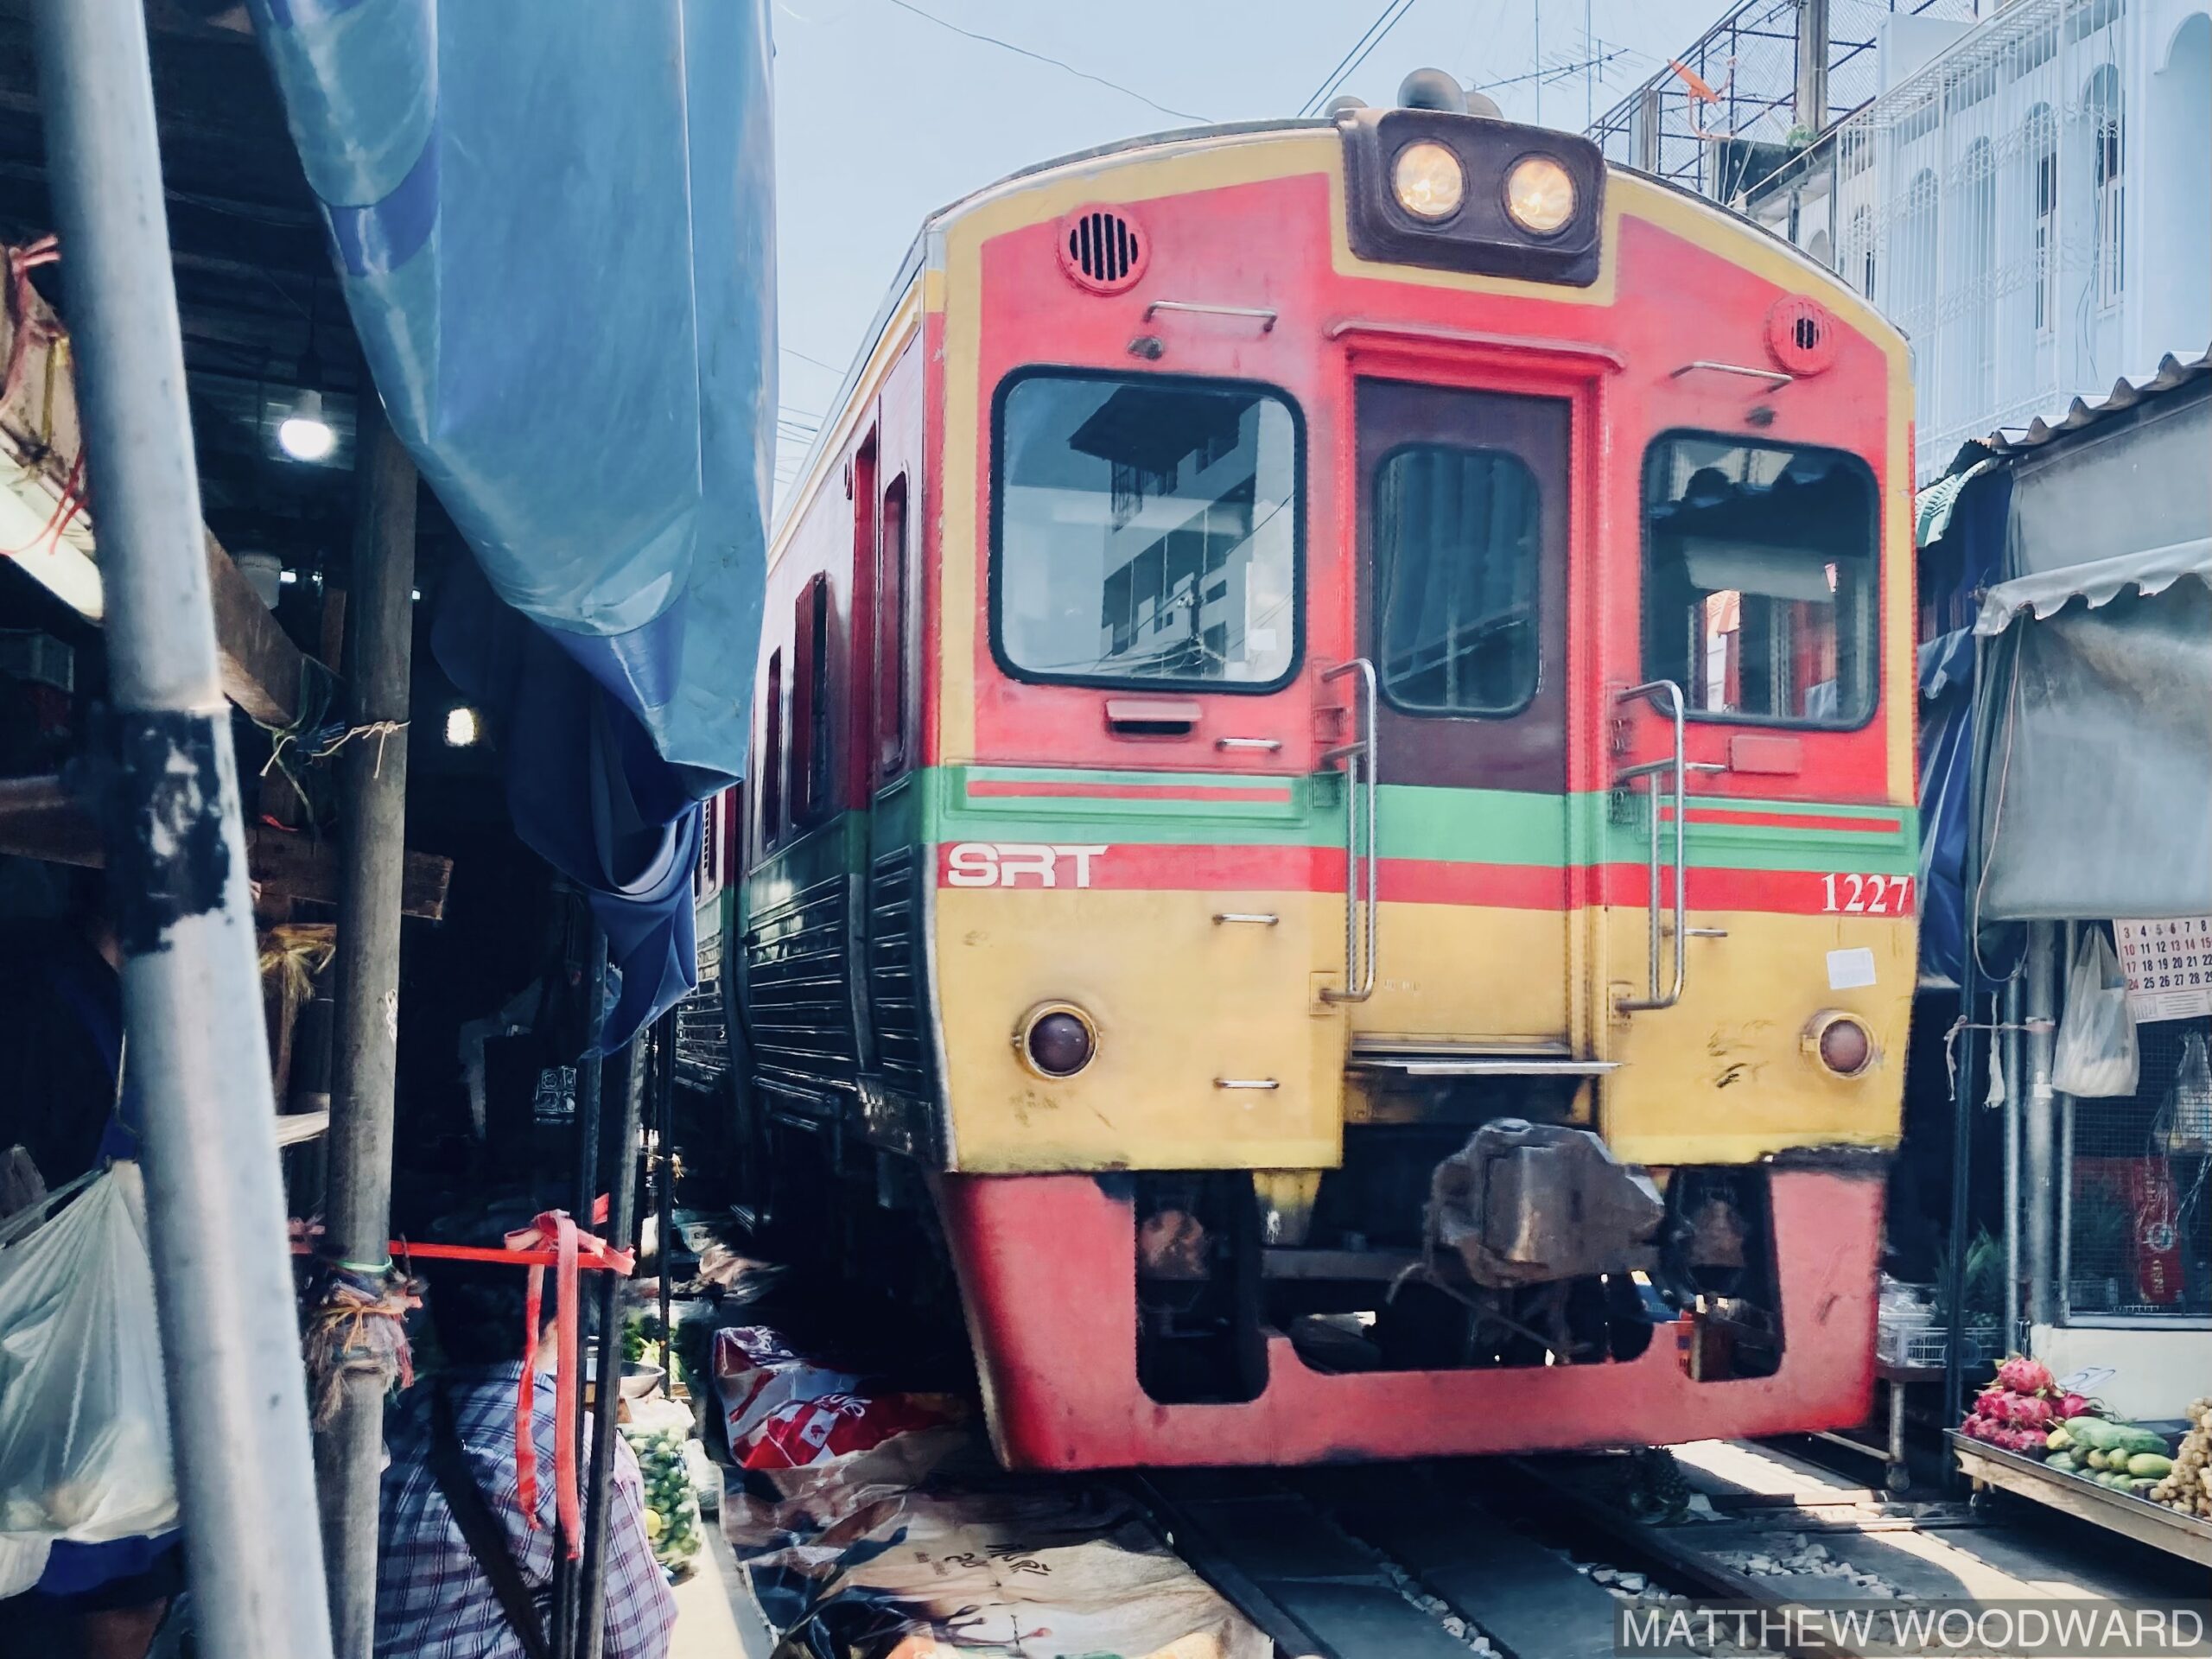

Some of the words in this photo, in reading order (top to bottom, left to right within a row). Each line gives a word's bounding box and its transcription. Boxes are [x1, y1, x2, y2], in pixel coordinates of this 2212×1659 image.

[948, 842, 1109, 888] SRT
[1821, 873, 1910, 912] 1227
[2140, 925, 2146, 937] 4
[2184, 921, 2190, 933] 7
[2201, 920, 2207, 931] 8
[2124, 945, 2135, 956] 10
[2140, 944, 2151, 954] 11
[2156, 941, 2166, 952] 12
[2171, 940, 2181, 951] 13
[2185, 938, 2196, 950] 14
[2201, 937, 2211, 949] 15
[2126, 963, 2137, 974] 17
[2143, 960, 2153, 971] 18
[2158, 958, 2168, 970] 19
[2172, 957, 2183, 969] 20
[2187, 956, 2197, 967] 21
[2128, 979, 2139, 990] 24
[2144, 977, 2155, 989] 25
[2159, 976, 2170, 988] 26
[2174, 974, 2184, 986] 27
[2189, 973, 2200, 984] 28
